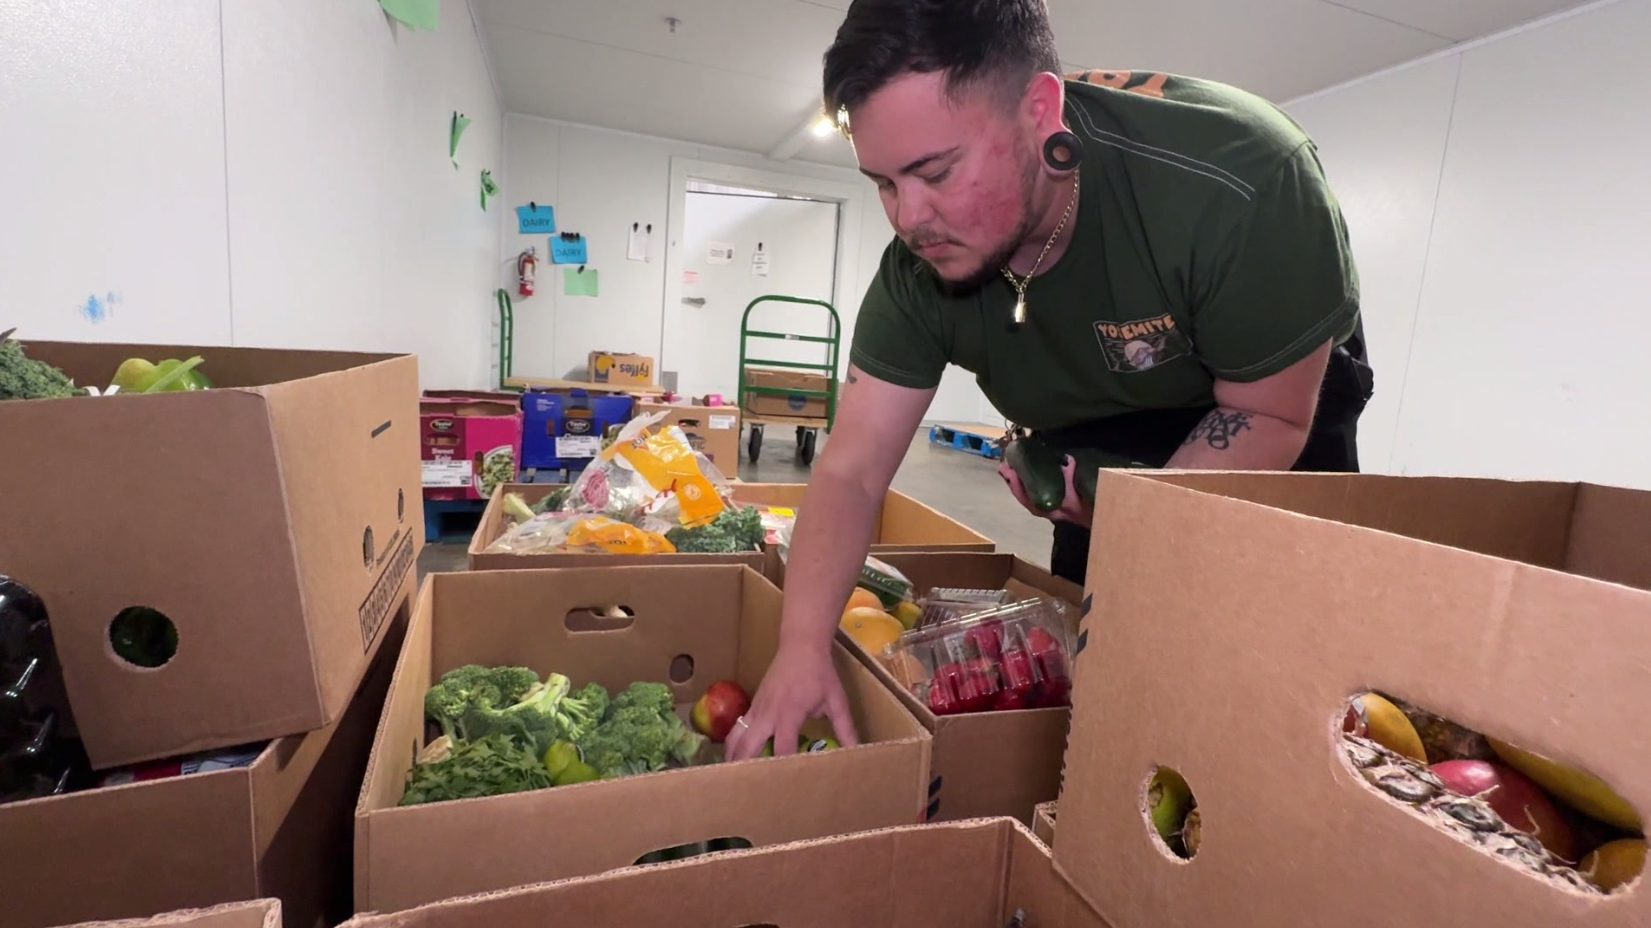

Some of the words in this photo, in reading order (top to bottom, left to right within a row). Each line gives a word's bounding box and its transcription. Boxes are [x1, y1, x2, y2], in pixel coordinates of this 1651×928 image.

[522, 219, 550, 227] DAIRY
[555, 248, 582, 257] DAIRY
[1097, 314, 1176, 340] YOEMITE
